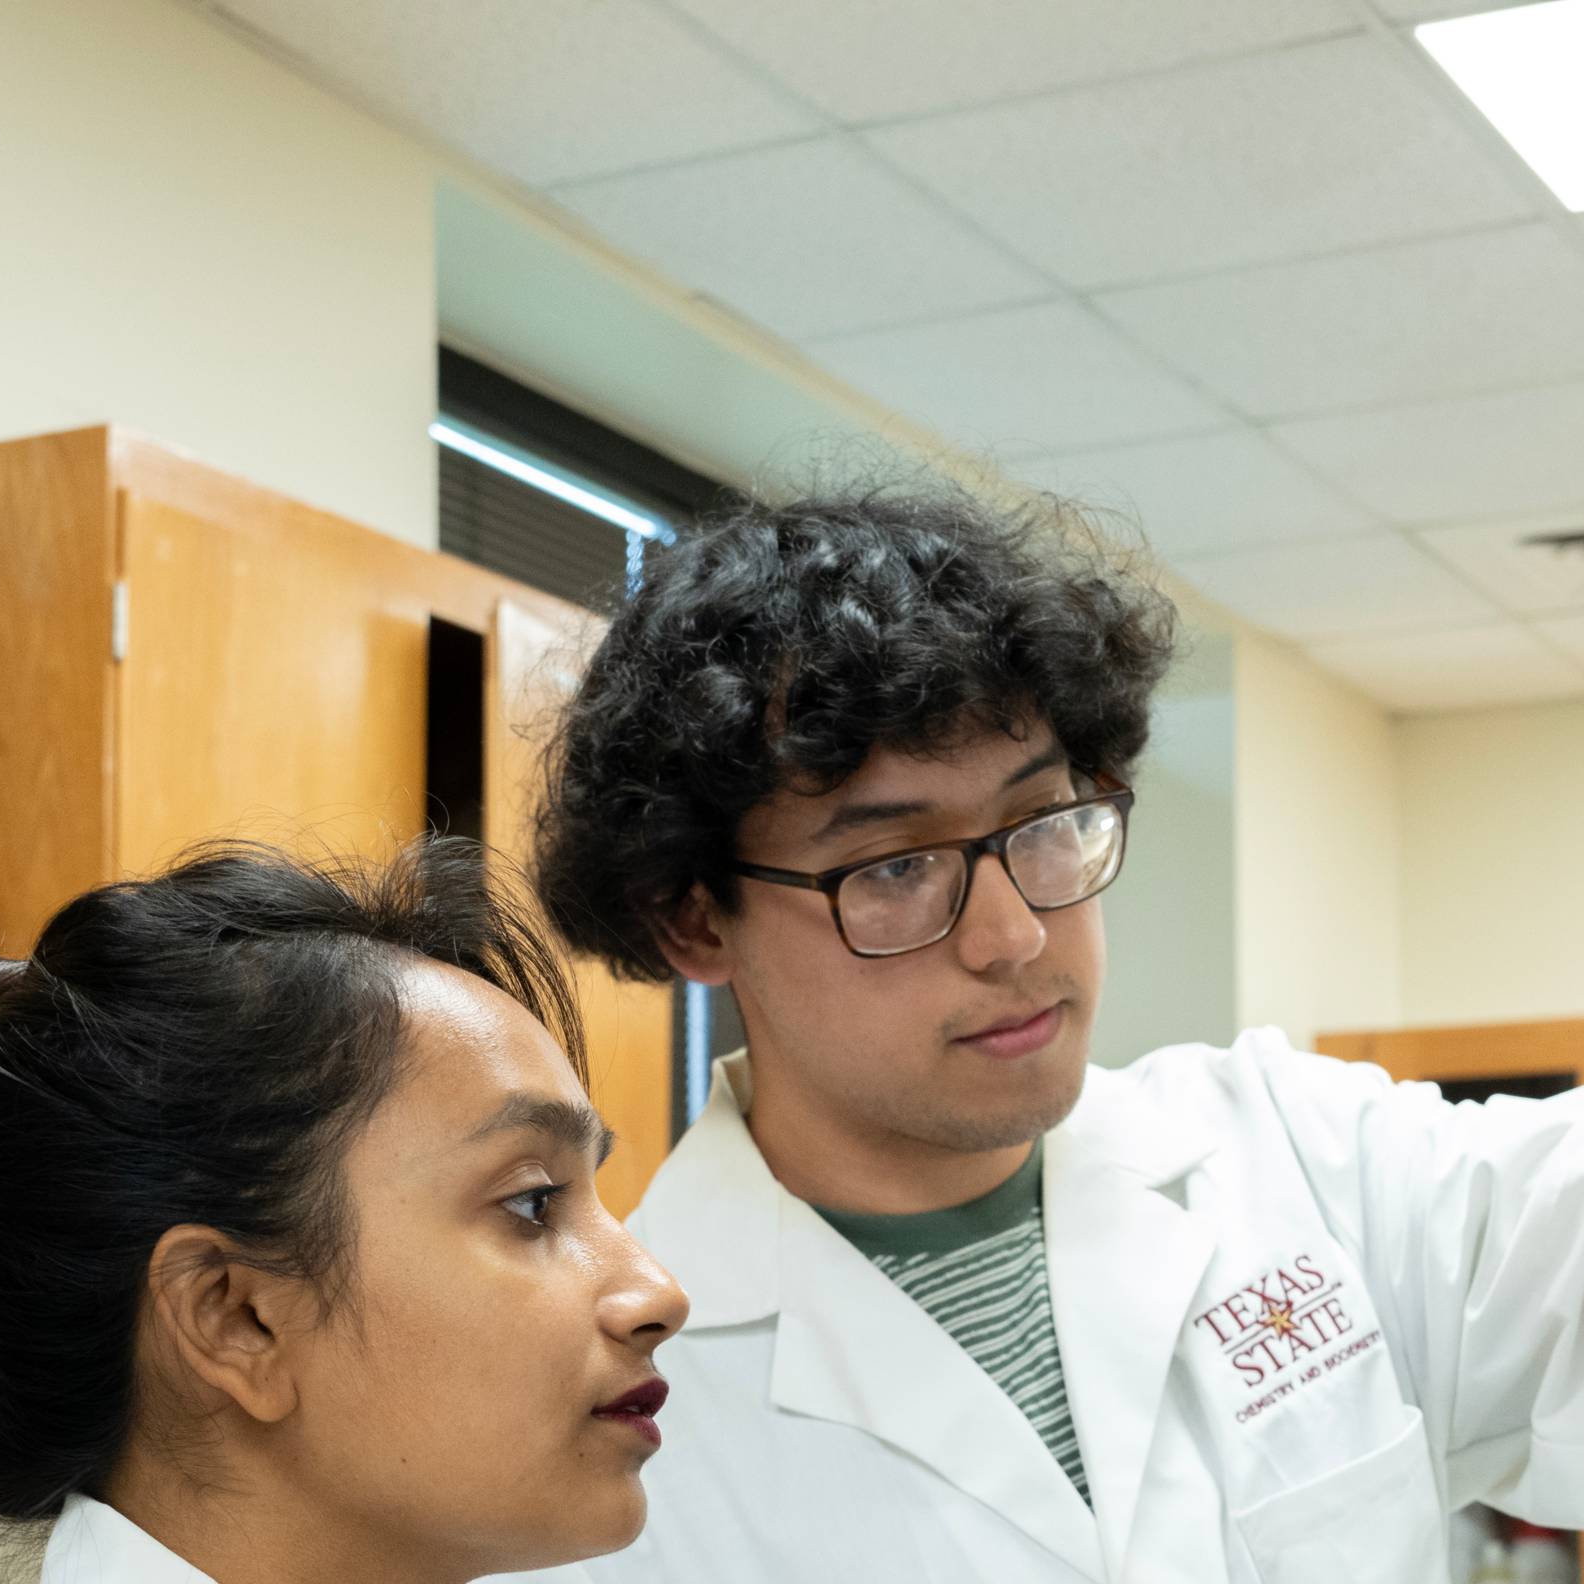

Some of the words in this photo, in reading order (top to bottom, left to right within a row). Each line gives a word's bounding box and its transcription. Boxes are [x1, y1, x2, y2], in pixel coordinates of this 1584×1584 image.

[1194, 1254, 1325, 1346] TEXAS
[1232, 1298, 1354, 1389] STATE
[1235, 1380, 1295, 1424] CHEMISTRY
[1299, 1365, 1322, 1385] AND
